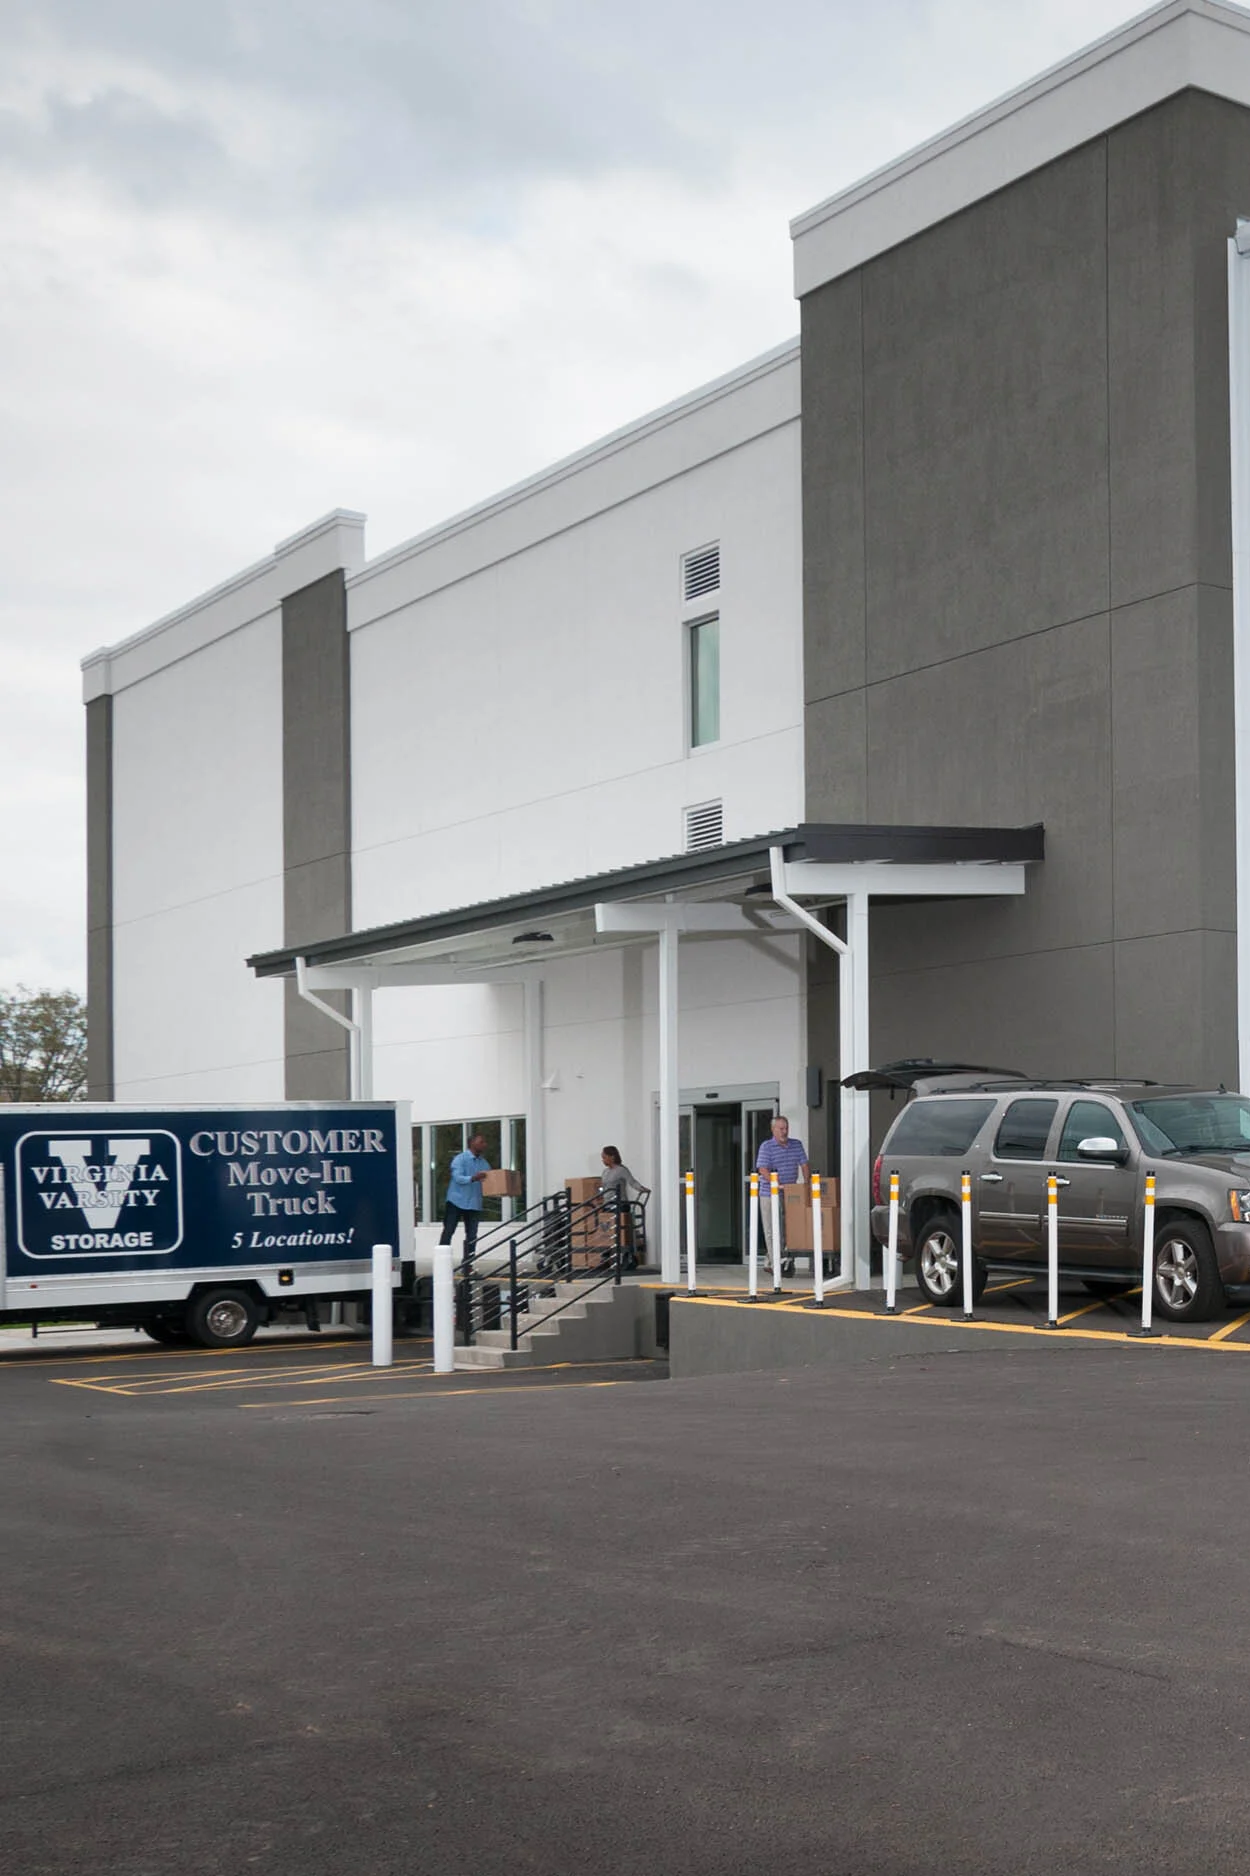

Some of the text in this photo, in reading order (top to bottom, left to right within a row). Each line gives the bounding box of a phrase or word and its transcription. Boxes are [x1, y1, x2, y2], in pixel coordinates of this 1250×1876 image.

[189, 1129, 387, 1156] CUSTOMER
[31, 1164, 169, 1184] VIRGINIA
[227, 1160, 352, 1187] Move-In
[38, 1189, 160, 1210] VARSITY
[247, 1190, 337, 1217] Truck
[51, 1232, 153, 1250] STORAGE
[231, 1228, 355, 1249] 5 Locations!
